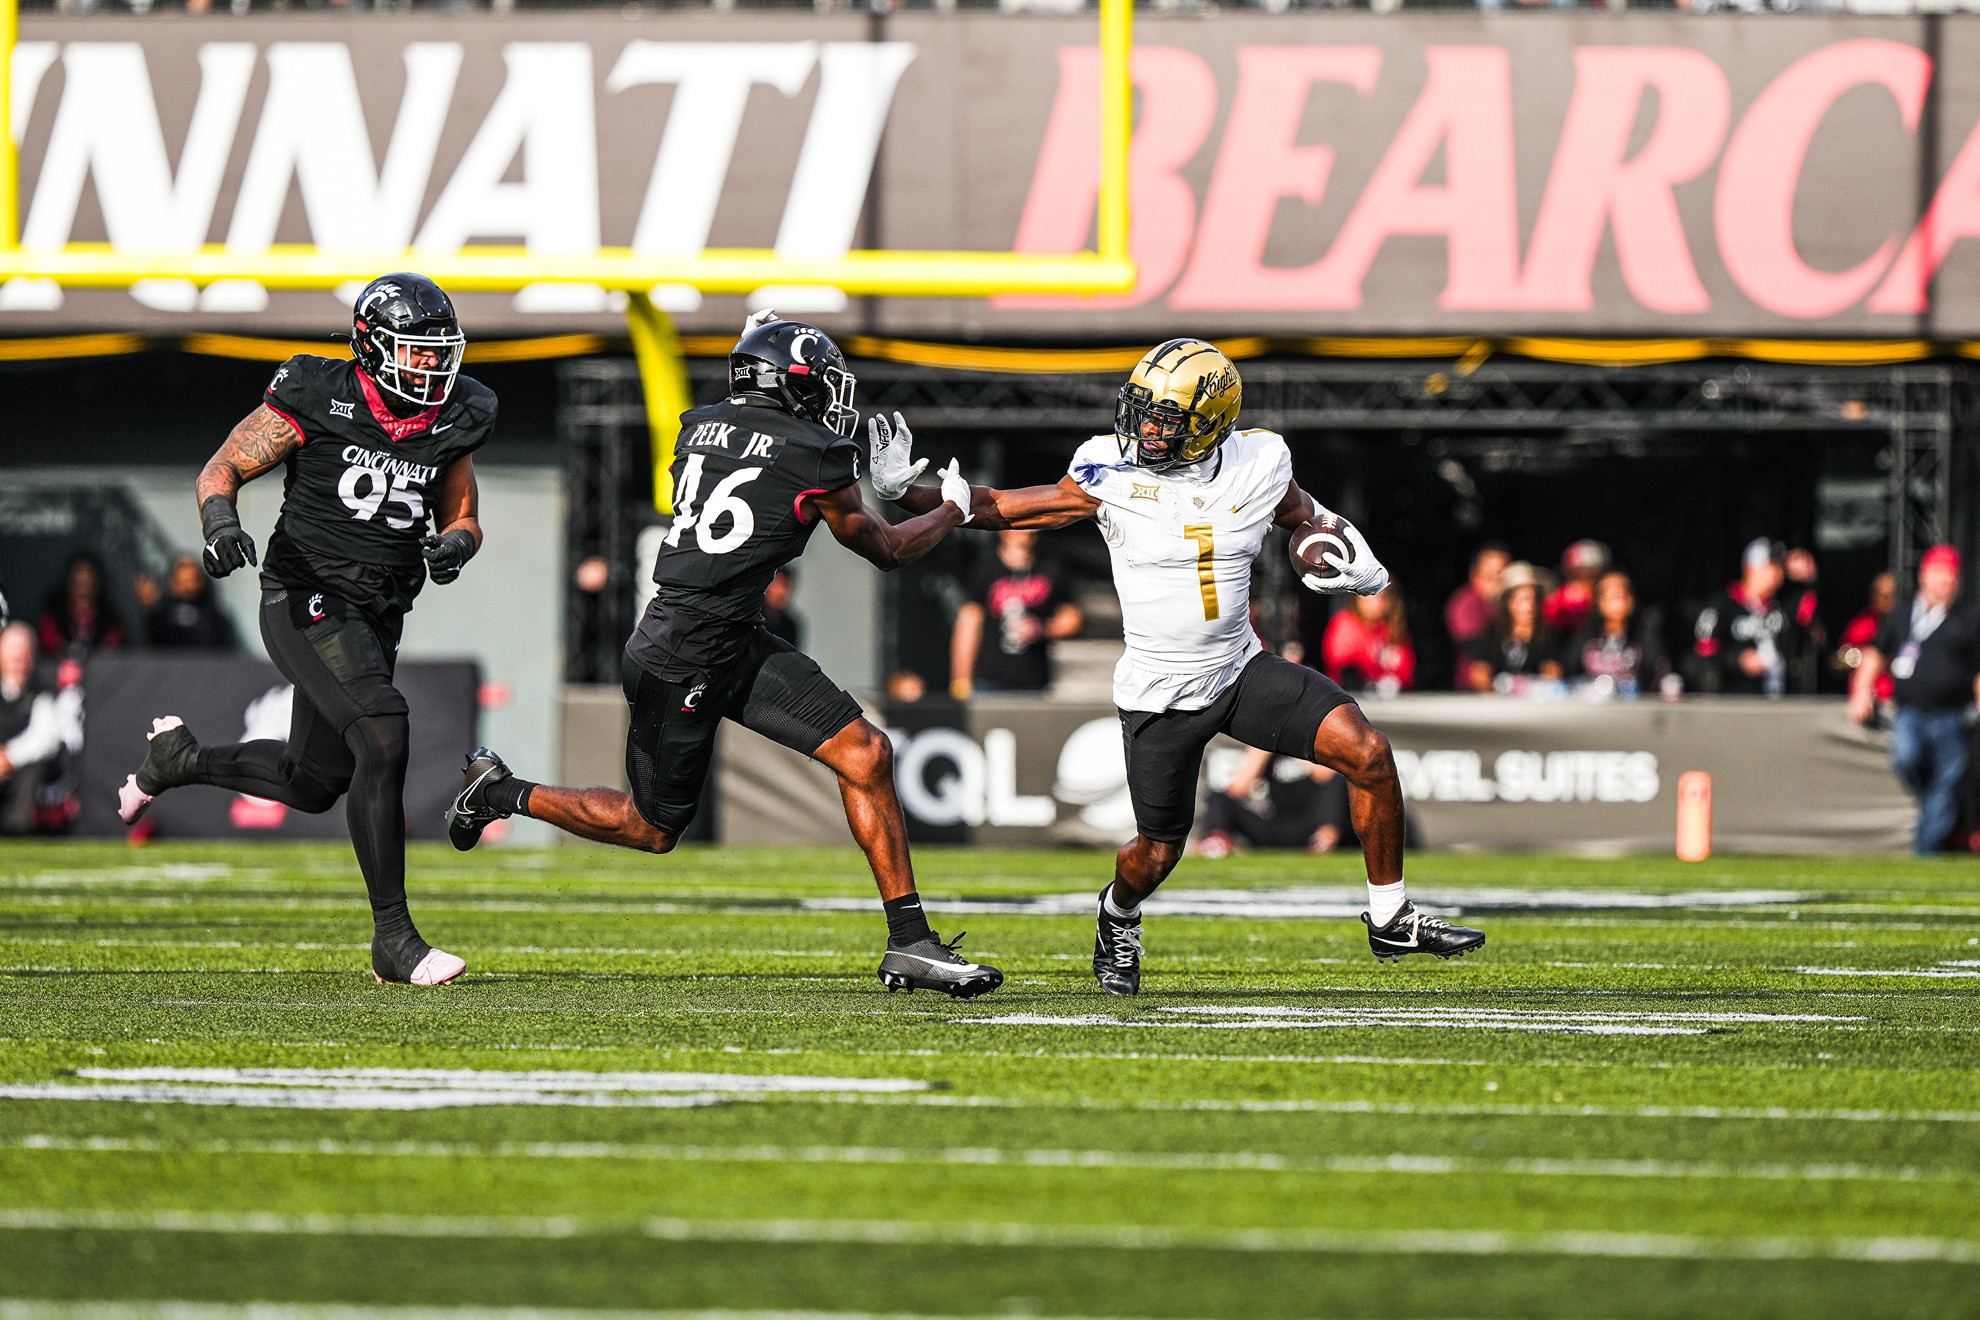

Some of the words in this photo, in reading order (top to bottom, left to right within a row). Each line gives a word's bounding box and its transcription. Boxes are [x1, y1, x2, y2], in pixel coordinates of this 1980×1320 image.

[1202, 363, 1239, 400] Knights
[342, 445, 438, 482] CINCINNATI
[687, 422, 737, 449] PEEK
[739, 431, 774, 459] JR.
[338, 465, 427, 529] 95
[663, 453, 764, 554] 46
[1184, 525, 1219, 621] 1
[886, 727, 1057, 827] QL
[1495, 750, 1660, 803] SUITES
